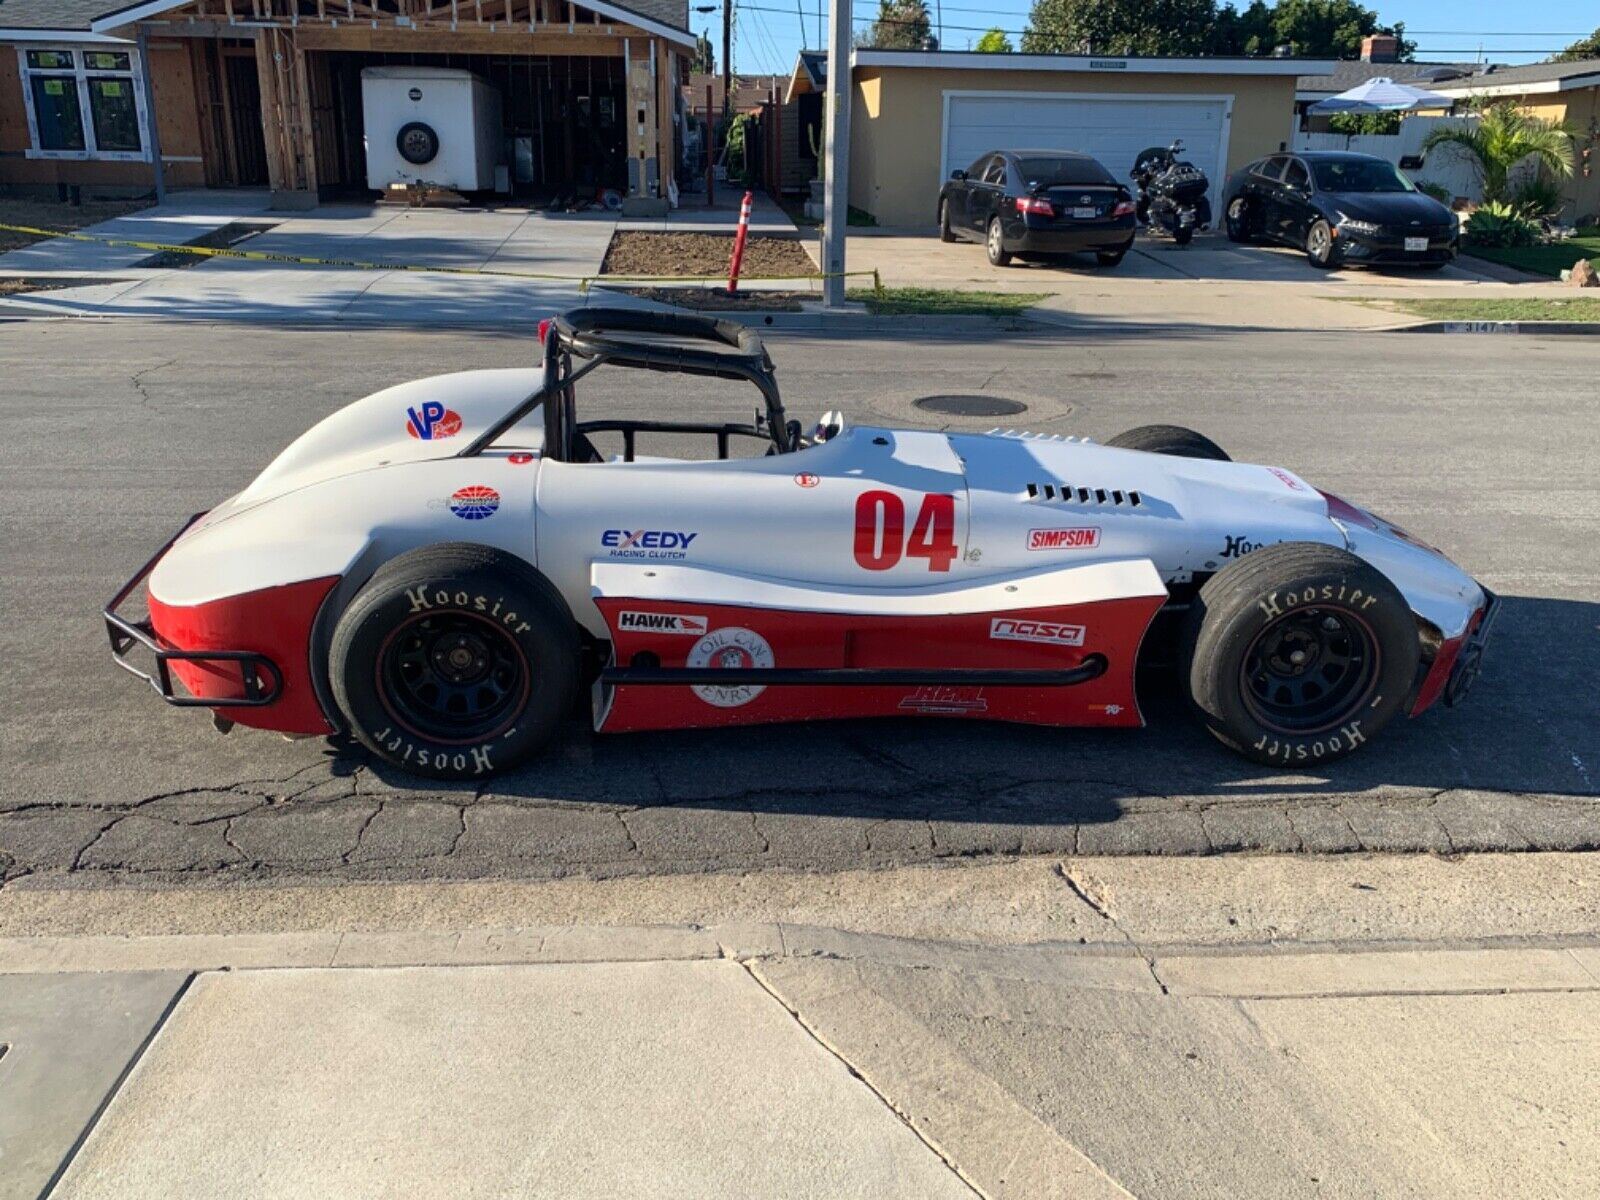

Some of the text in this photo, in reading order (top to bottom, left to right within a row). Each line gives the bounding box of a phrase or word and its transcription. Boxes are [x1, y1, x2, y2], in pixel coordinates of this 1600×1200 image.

[1465, 322, 1497, 333] 3147
[407, 401, 444, 440] VP
[601, 529, 698, 549] EXEDY
[853, 490, 958, 572] 04
[1031, 530, 1096, 547] SIMPSON
[609, 550, 686, 559] RACING CLUTCH
[404, 585, 531, 634] Hoosier
[1258, 578, 1377, 622] Hoosier
[622, 613, 677, 629] HAWK
[700, 633, 728, 655] OIL
[700, 686, 753, 703] ENRY
[374, 727, 495, 774] Hoosier
[1253, 720, 1367, 764] Hoosier
